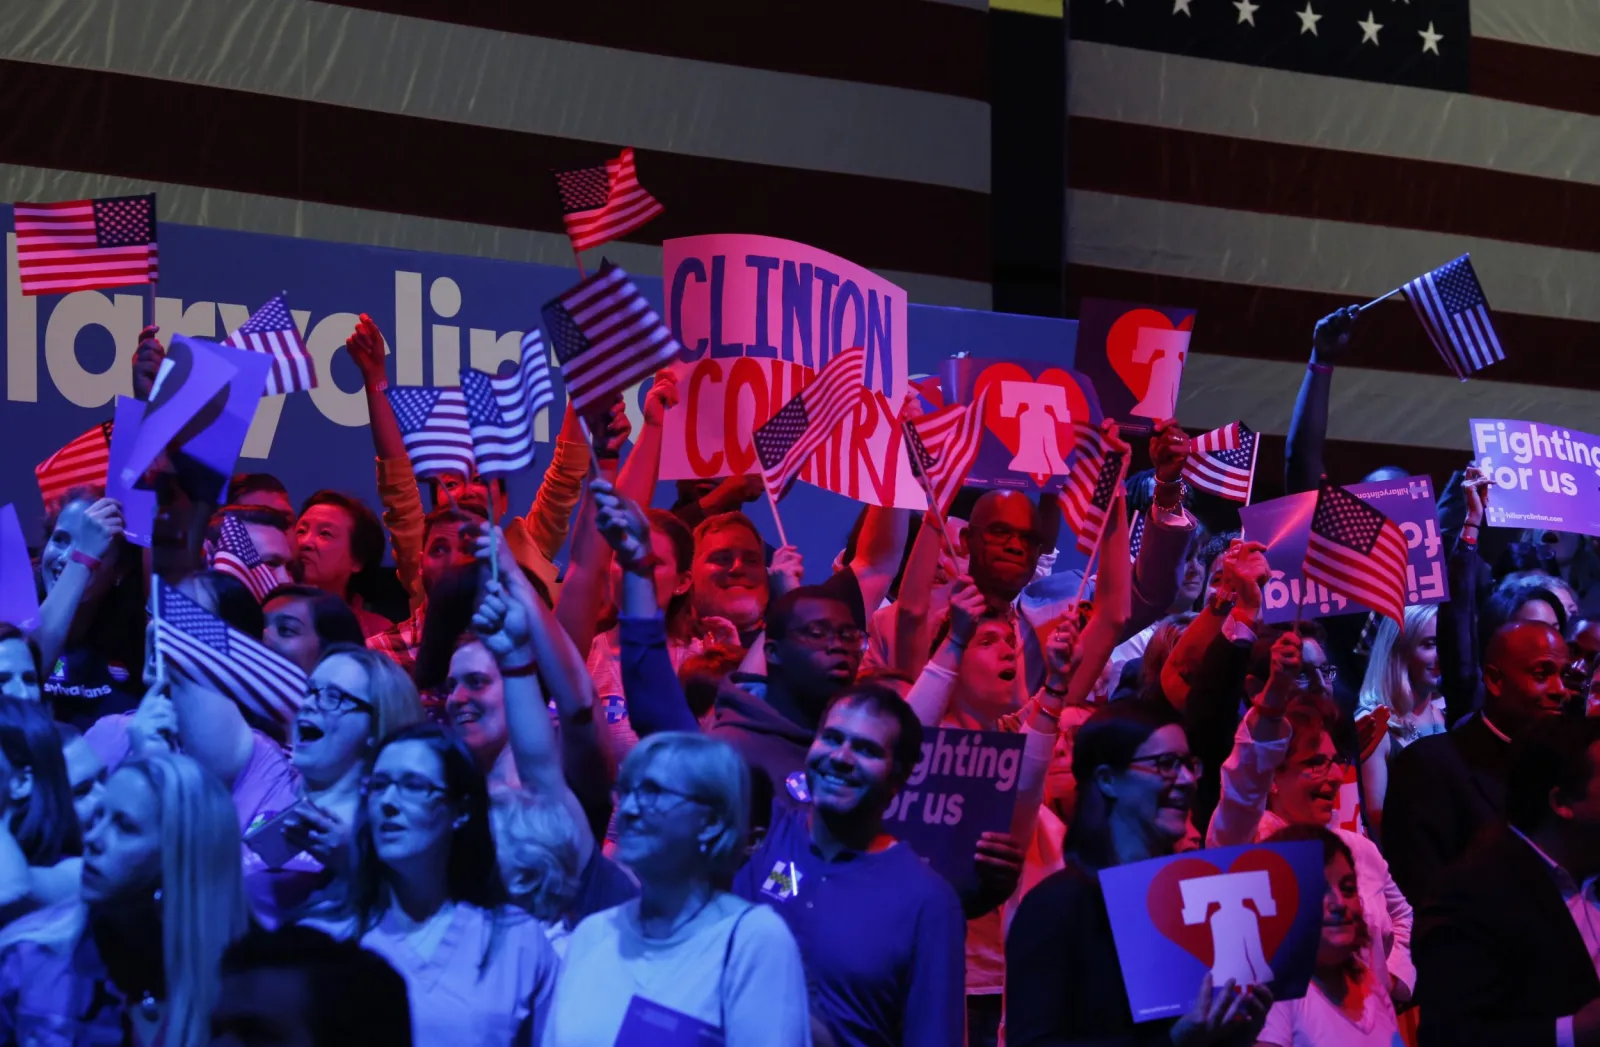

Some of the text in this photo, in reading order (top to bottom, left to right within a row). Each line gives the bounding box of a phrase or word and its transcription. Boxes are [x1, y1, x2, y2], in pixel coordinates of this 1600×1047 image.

[670, 255, 893, 399] CLINTON
[685, 357, 907, 507] CORY
[1354, 487, 1408, 499] hillaryclinton.
[1480, 457, 1578, 496] for us
[1506, 511, 1564, 523] hillaryclinton.com
[1398, 519, 1441, 558] fo
[1264, 561, 1445, 613] Fiing
[905, 730, 1021, 791] ghting
[922, 793, 965, 825] us
